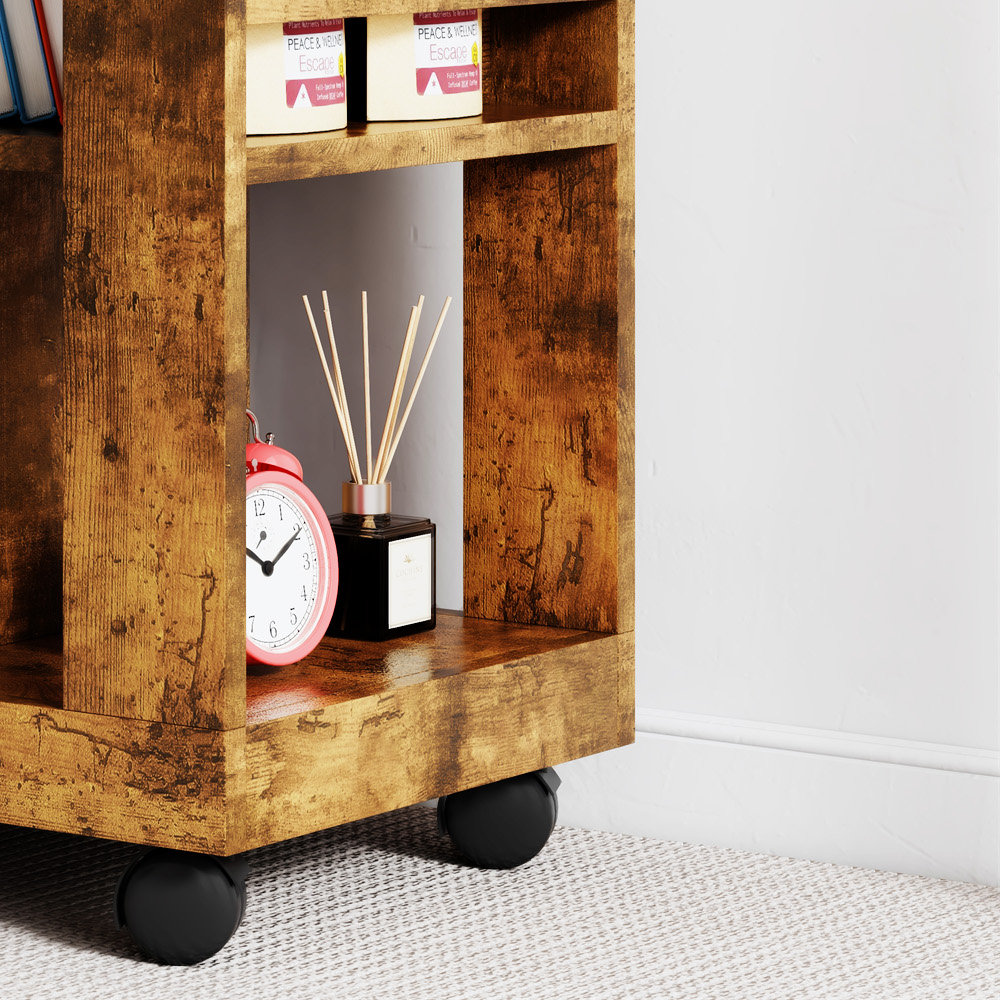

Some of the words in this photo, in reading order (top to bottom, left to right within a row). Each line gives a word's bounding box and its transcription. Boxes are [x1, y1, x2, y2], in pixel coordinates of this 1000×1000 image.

[418, 26, 446, 40] PEACE
[287, 37, 315, 51] PEACE
[430, 44, 467, 62] Escape
[299, 55, 335, 72] Escape
[254, 499, 266, 517] 12
[279, 504, 283, 521] 1
[292, 523, 301, 541] 2
[302, 553, 311, 570] 3
[301, 585, 308, 601] 4
[248, 615, 256, 633] 7
[289, 607, 298, 626] 5
[269, 621, 278, 639] 6
